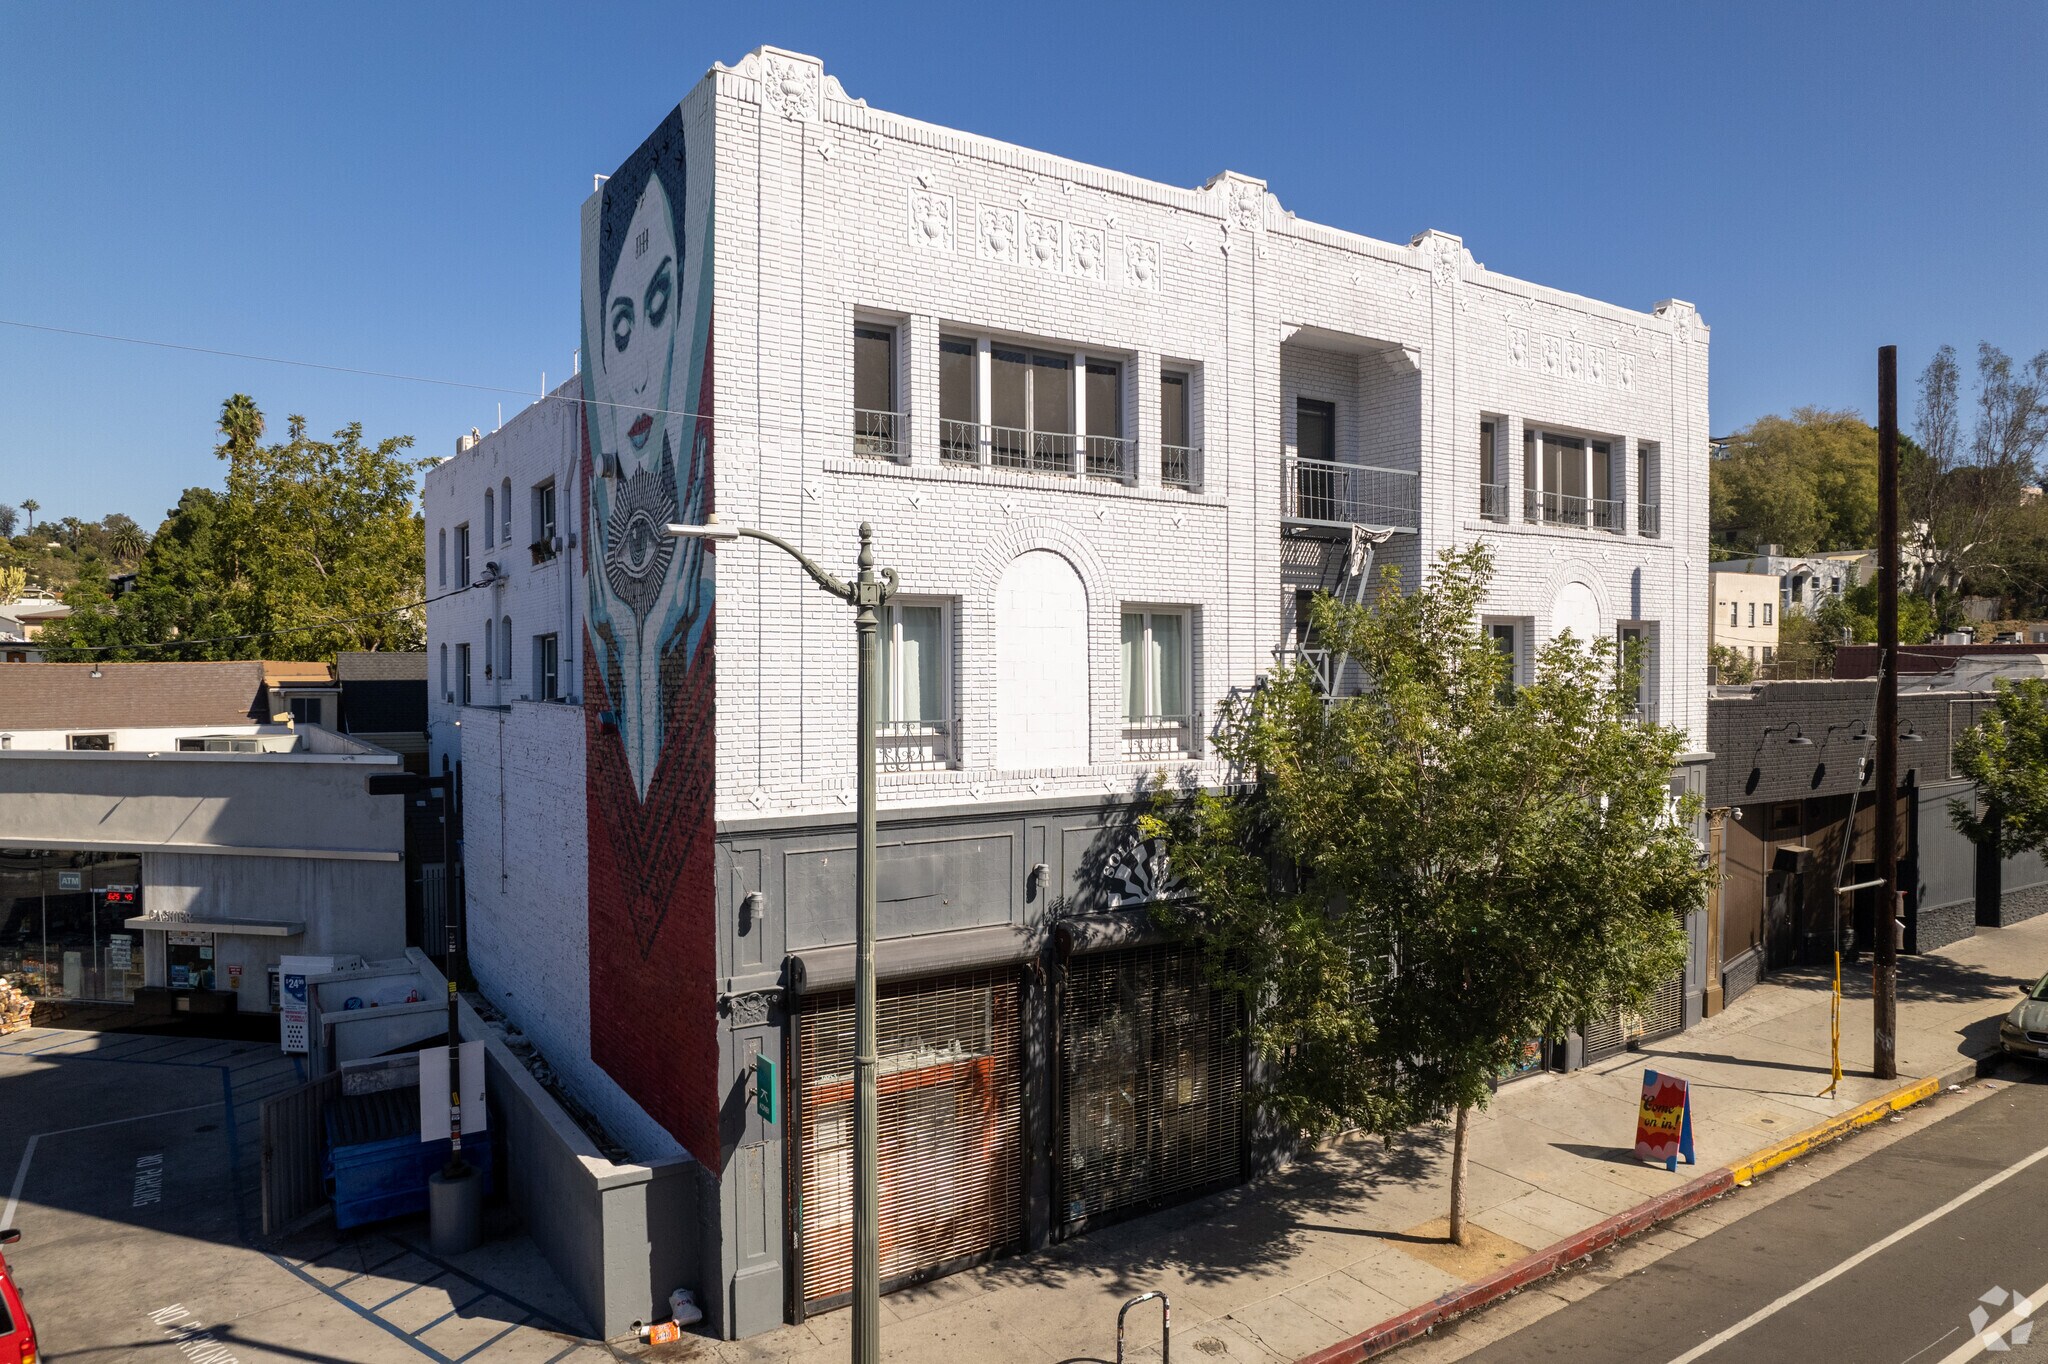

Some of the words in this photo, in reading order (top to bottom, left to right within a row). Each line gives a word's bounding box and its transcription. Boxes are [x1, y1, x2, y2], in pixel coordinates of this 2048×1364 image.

[61, 877, 79, 886] ATM
[148, 909, 192, 923] CASHIER
[1642, 1094, 1675, 1114] Come
[1644, 1118, 1657, 1127] on
[1661, 1114, 1680, 1130] in!
[136, 1153, 164, 1168] NO
[132, 1168, 163, 1208] PARKING
[147, 1302, 191, 1326] NO
